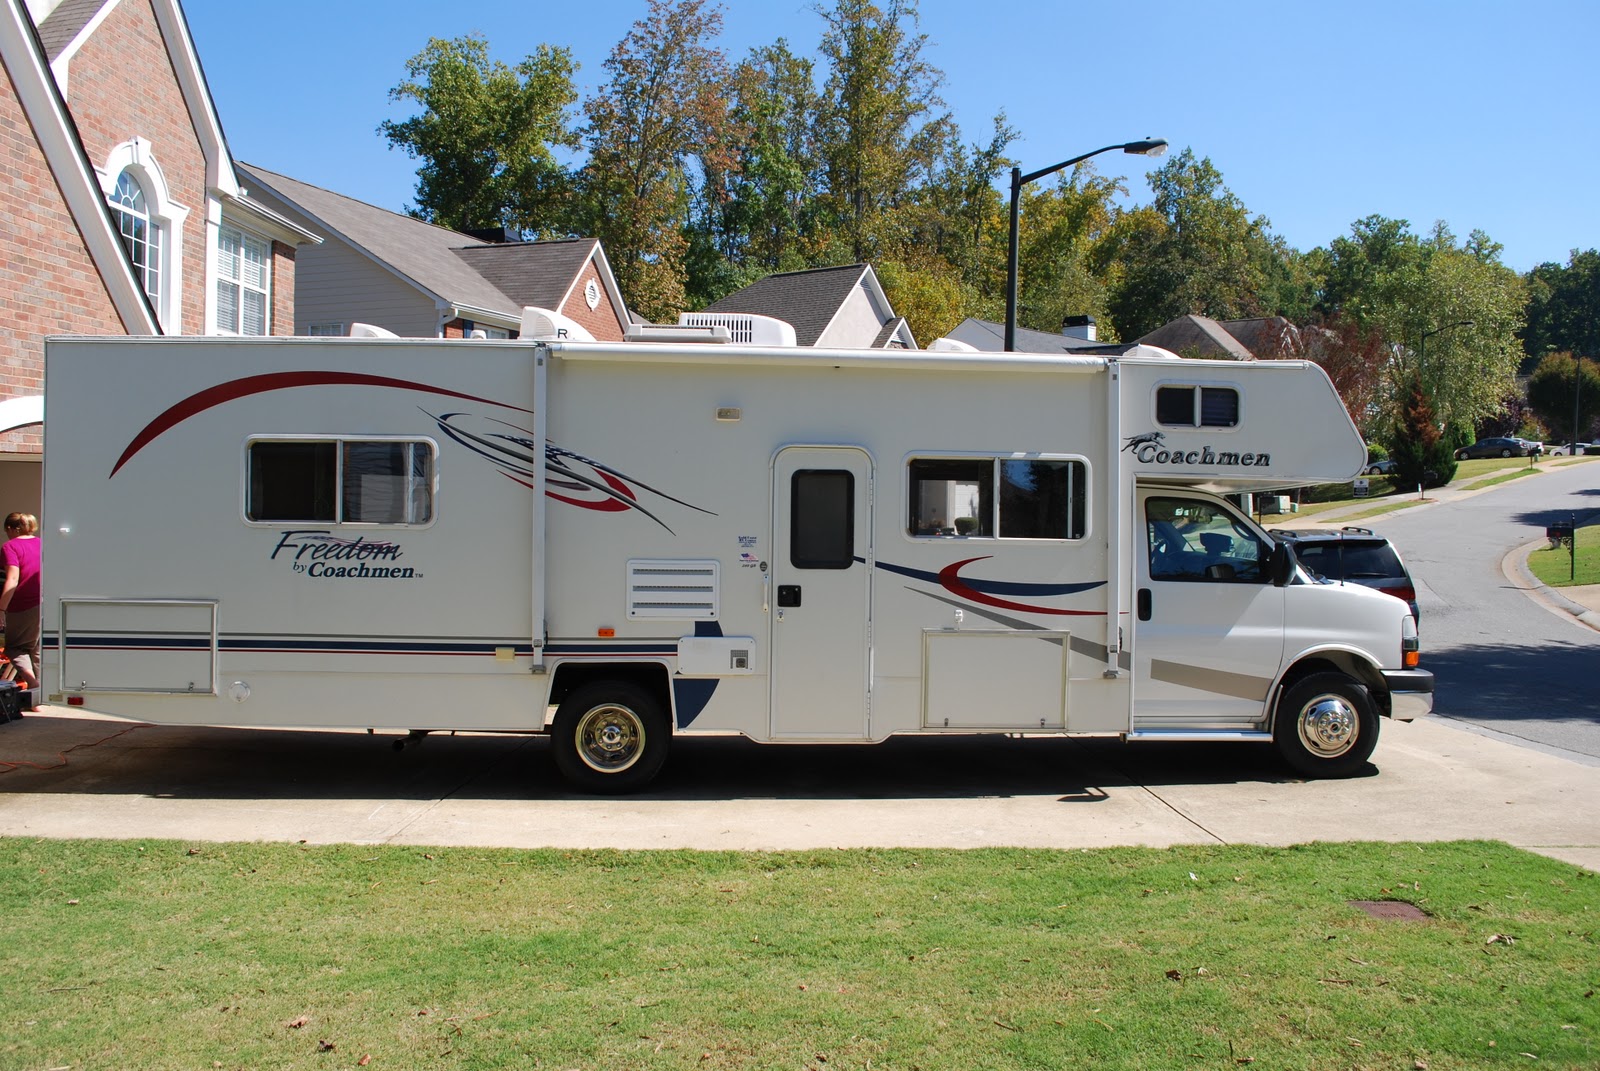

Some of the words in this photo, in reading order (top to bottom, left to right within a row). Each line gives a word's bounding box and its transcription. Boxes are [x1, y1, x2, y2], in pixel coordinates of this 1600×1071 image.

[557, 328, 568, 339] R
[1137, 444, 1271, 467] Coachmen
[271, 530, 403, 561] Freedom
[292, 562, 307, 573] by
[308, 562, 414, 578] Coachmen
